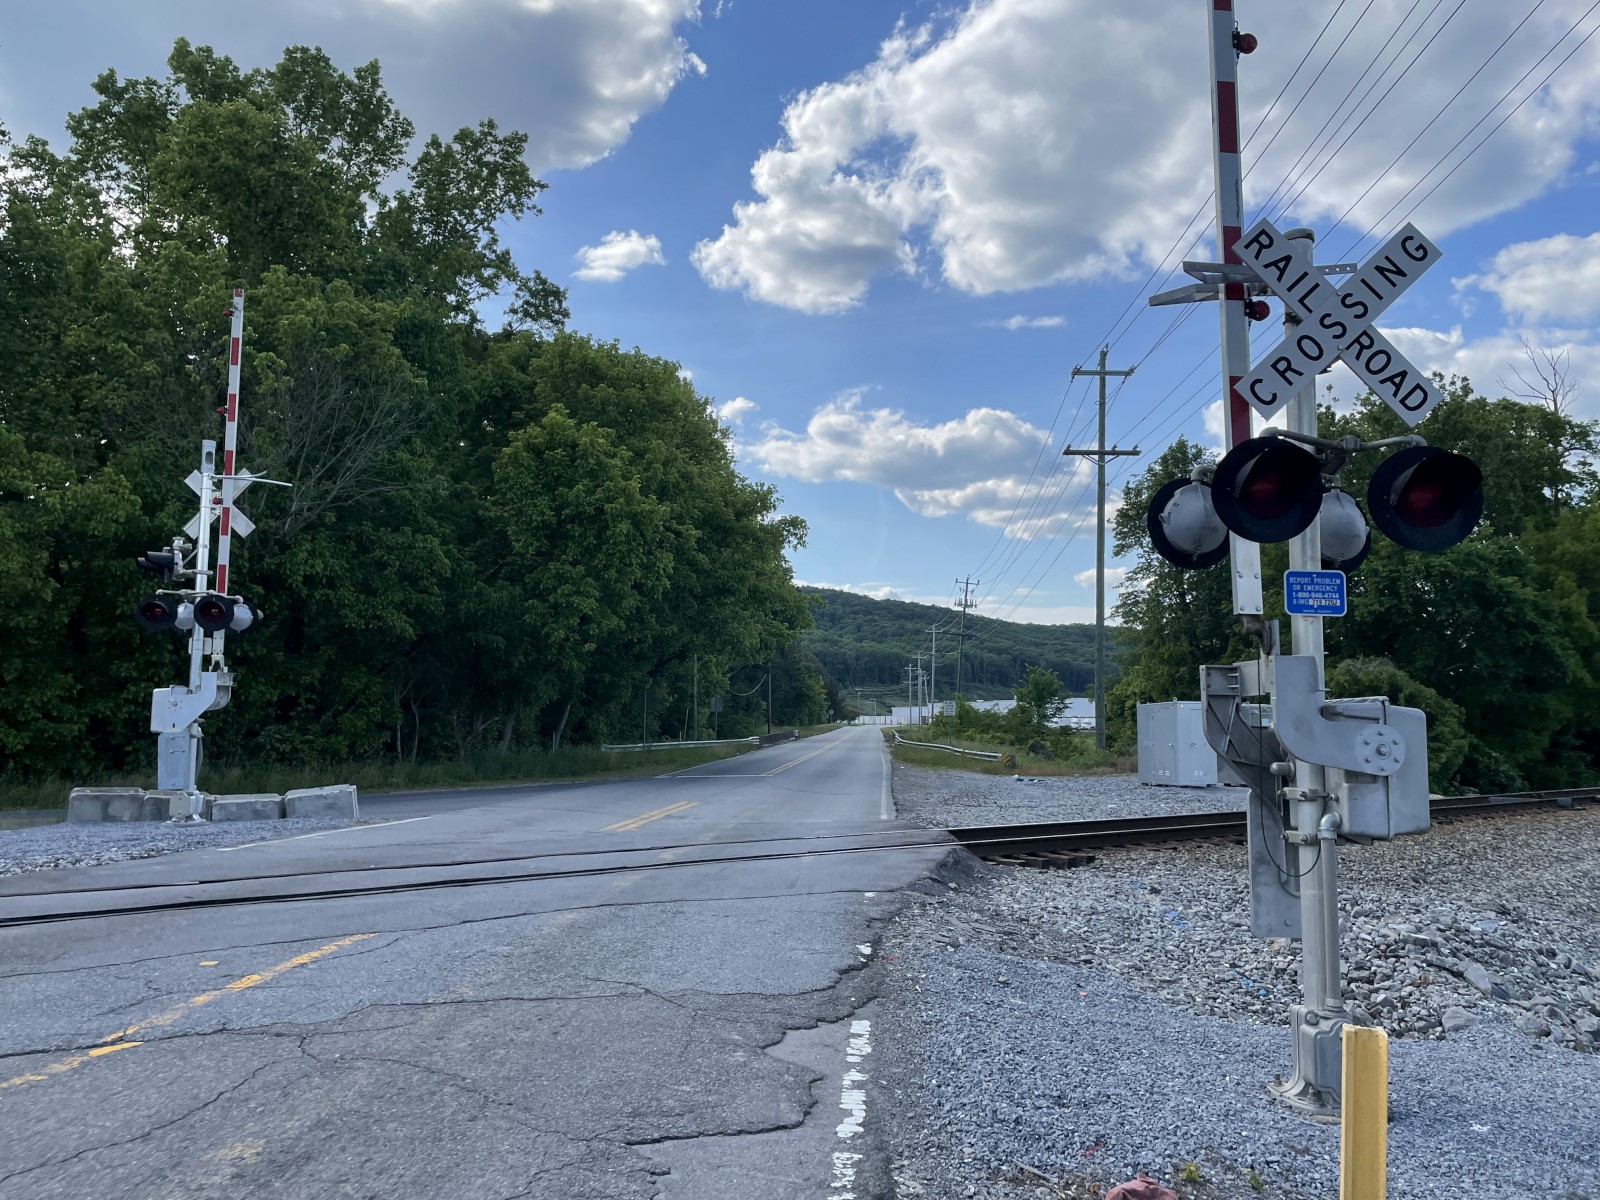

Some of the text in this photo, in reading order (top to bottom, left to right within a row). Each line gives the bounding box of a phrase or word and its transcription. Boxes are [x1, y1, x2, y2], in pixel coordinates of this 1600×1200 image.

[1243, 227, 1429, 412] RAIL ROAD
[1249, 235, 1429, 406] CROSSING
